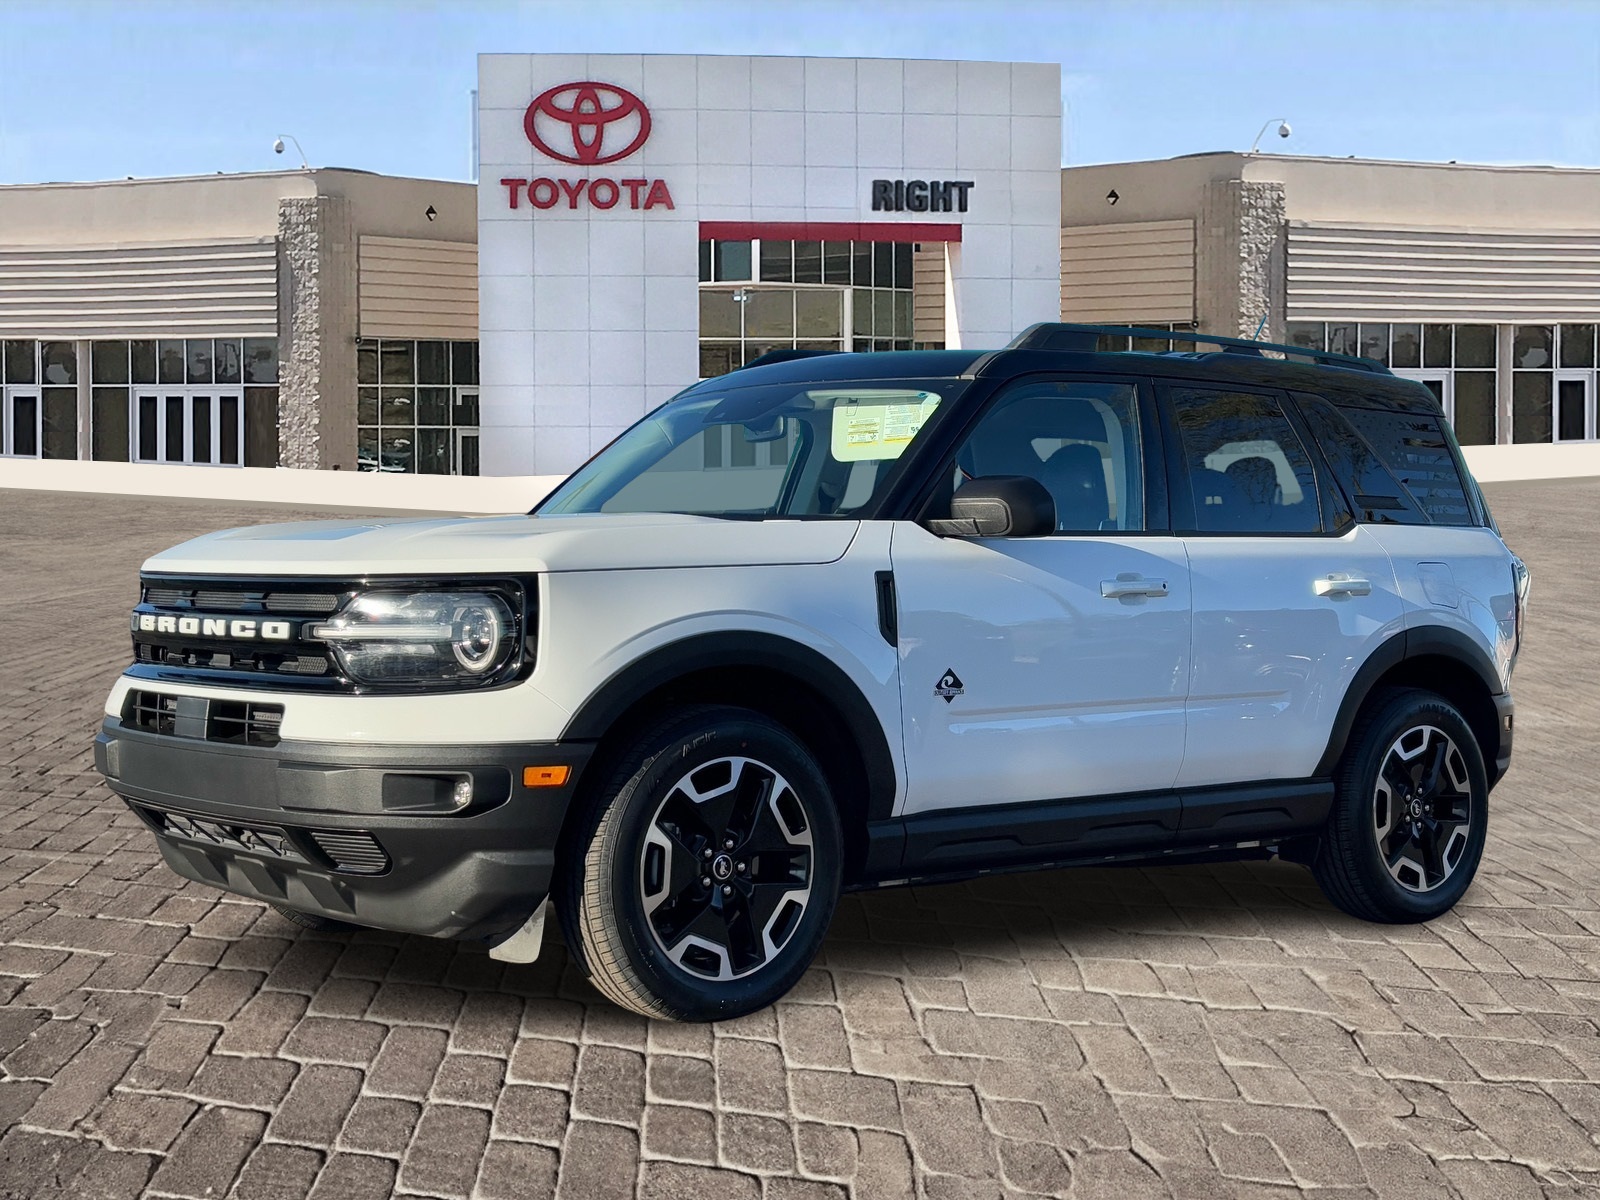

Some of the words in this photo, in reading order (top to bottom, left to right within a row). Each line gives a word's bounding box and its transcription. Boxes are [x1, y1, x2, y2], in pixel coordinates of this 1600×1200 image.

[500, 178, 675, 210] TOYOTA
[872, 179, 975, 213] RIGHT
[139, 615, 291, 640] BRONCO
